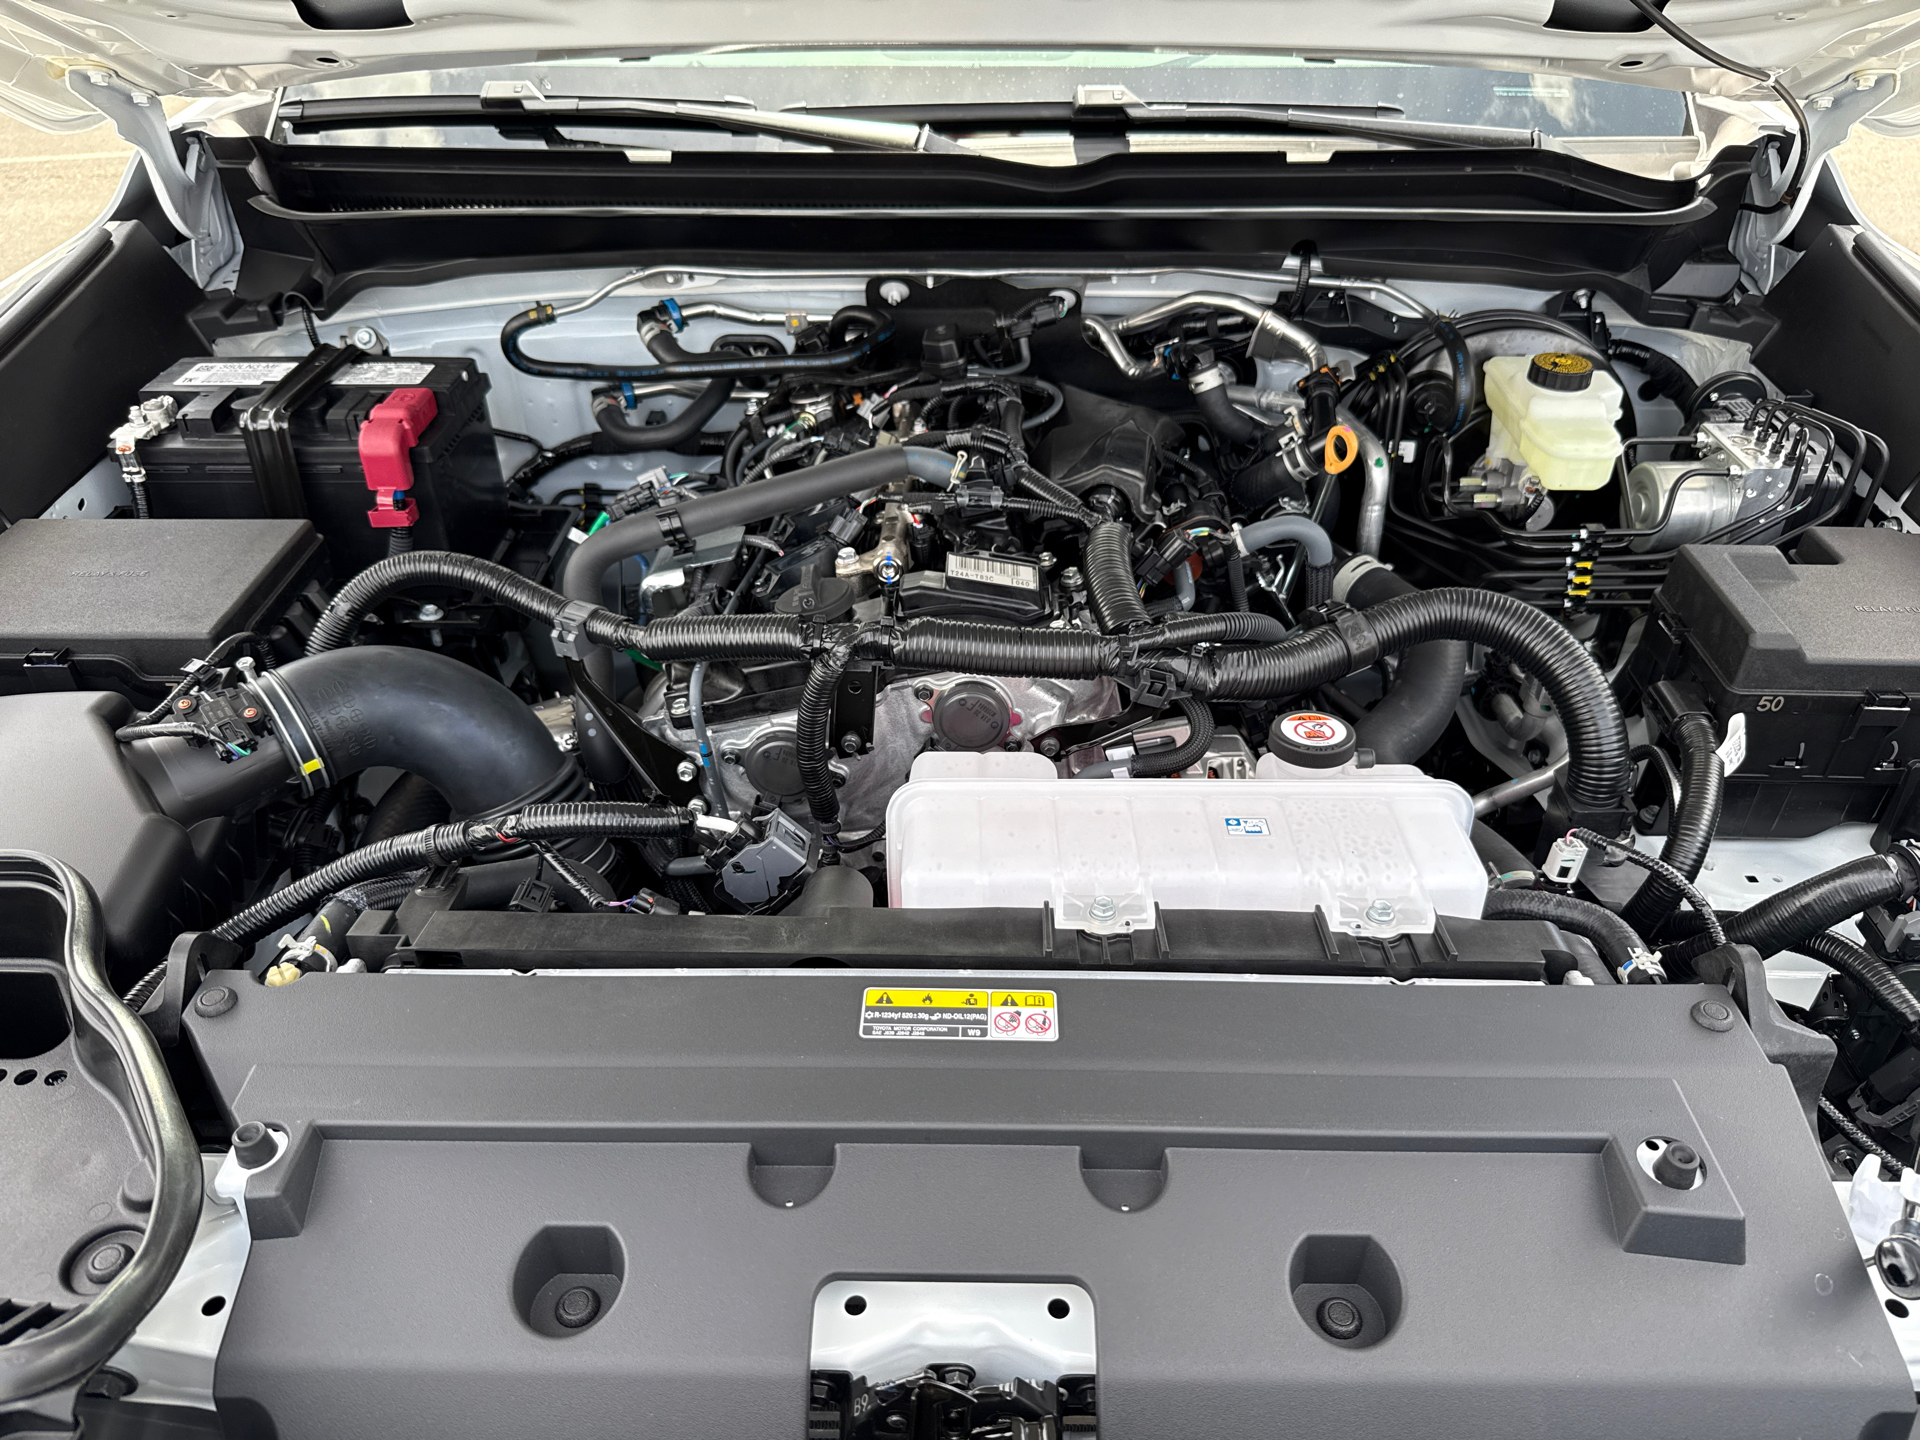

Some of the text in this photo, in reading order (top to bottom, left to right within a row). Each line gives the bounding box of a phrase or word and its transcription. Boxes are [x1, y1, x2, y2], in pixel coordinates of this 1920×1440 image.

[1015, 580, 1030, 588] 040
[1853, 605, 1892, 613] RELAY
[1756, 696, 1785, 712] 50
[874, 1011, 901, 1020] R-1234yf
[967, 1029, 981, 1037] W9
